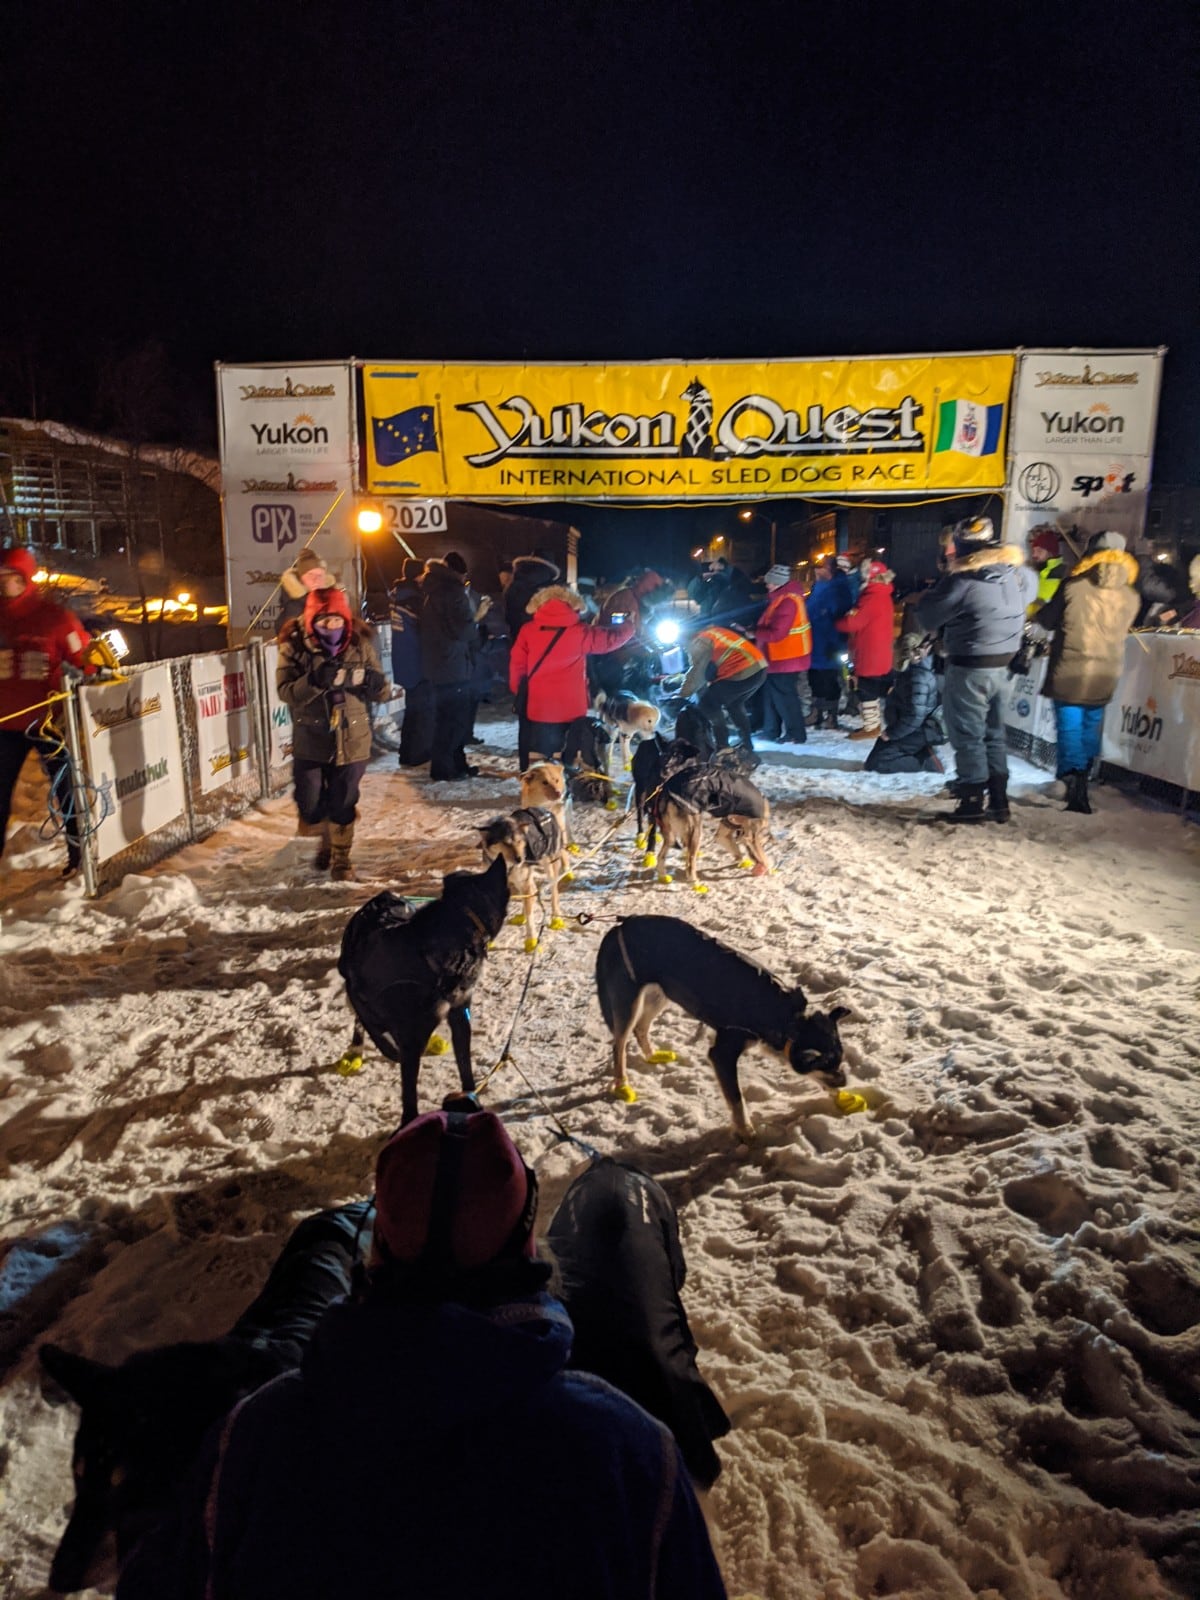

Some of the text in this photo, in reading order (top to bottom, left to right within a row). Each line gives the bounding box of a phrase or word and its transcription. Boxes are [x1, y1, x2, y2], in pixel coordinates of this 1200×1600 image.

[250, 422, 328, 445] Yukon
[454, 394, 925, 468] Yukon Quest
[1040, 411, 1125, 433] Yukon
[1045, 437, 1077, 445] LARGER
[500, 463, 916, 486] INTERNATIONAL SLED DOG RACE
[255, 507, 294, 541] PIX
[386, 503, 443, 530] 2020
